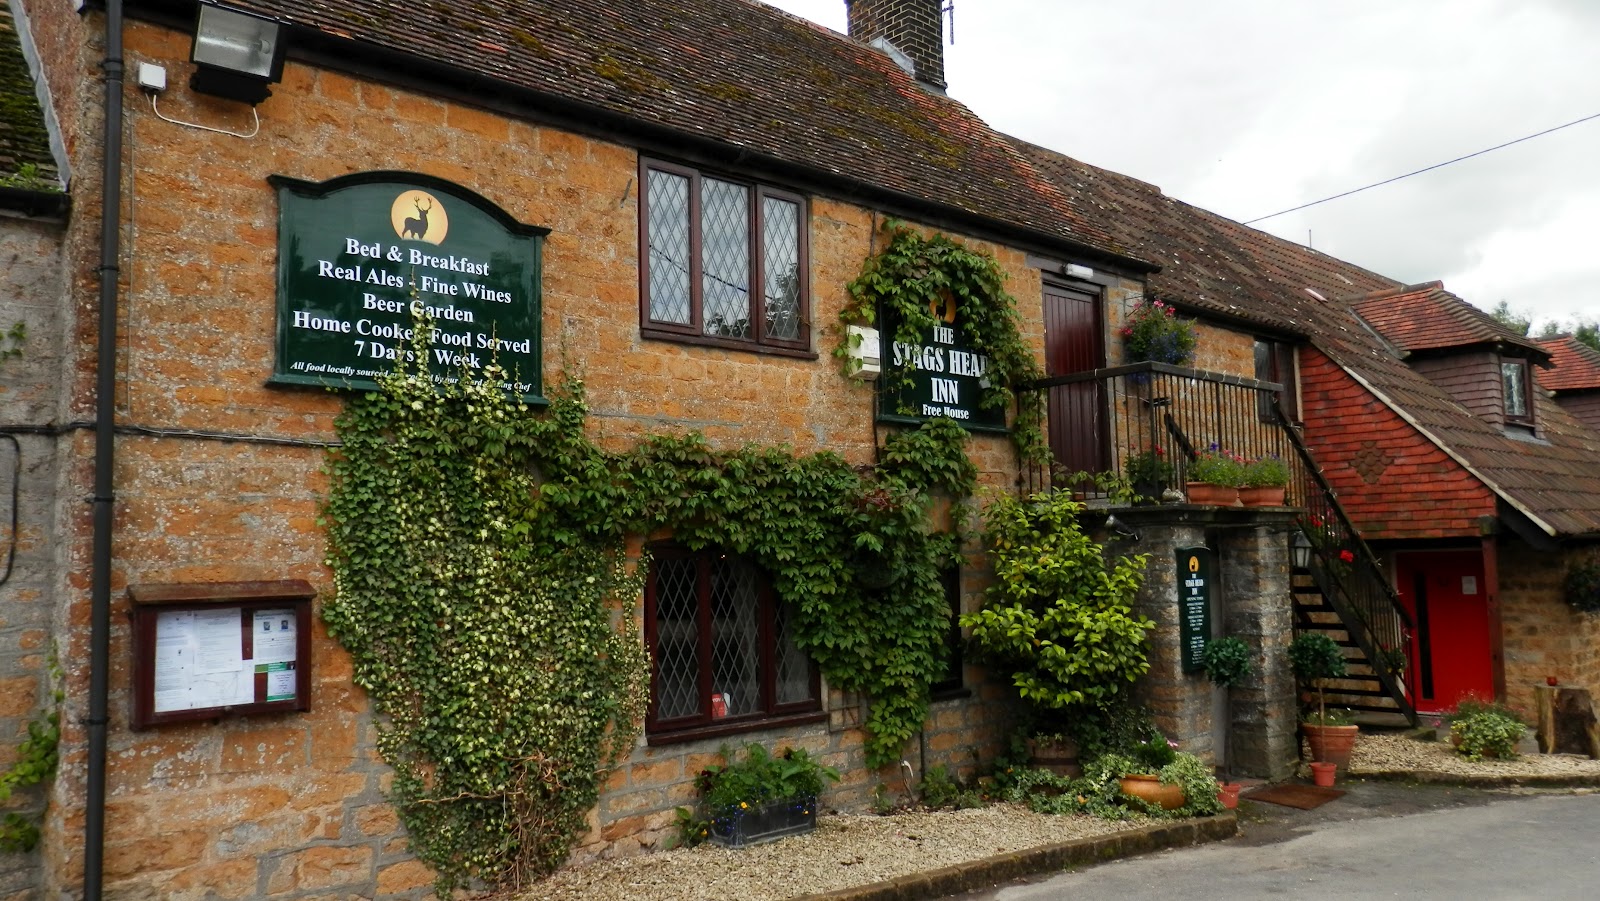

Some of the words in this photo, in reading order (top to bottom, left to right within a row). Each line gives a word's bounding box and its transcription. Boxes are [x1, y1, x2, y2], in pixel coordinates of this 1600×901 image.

[345, 237, 381, 259] Bed
[386, 245, 403, 262] &
[408, 248, 490, 277] Breakfast
[318, 259, 361, 282] Real
[365, 268, 404, 288] Ales
[420, 275, 458, 296] Fine
[462, 281, 512, 304] Wines
[362, 293, 405, 314] Beer
[409, 299, 474, 323] Garden
[292, 310, 351, 334] Home
[356, 318, 417, 342] Cooke
[430, 327, 472, 348] Food
[476, 332, 531, 354] Served
[932, 325, 955, 345] THE
[290, 361, 305, 370] All
[304, 362, 326, 373] food
[327, 364, 355, 377] locally
[353, 340, 365, 357] 7
[433, 348, 481, 369] Week
[892, 340, 945, 373] STAGS
[930, 377, 959, 405] INN
[922, 403, 942, 417] Free
[943, 406, 970, 420] House
